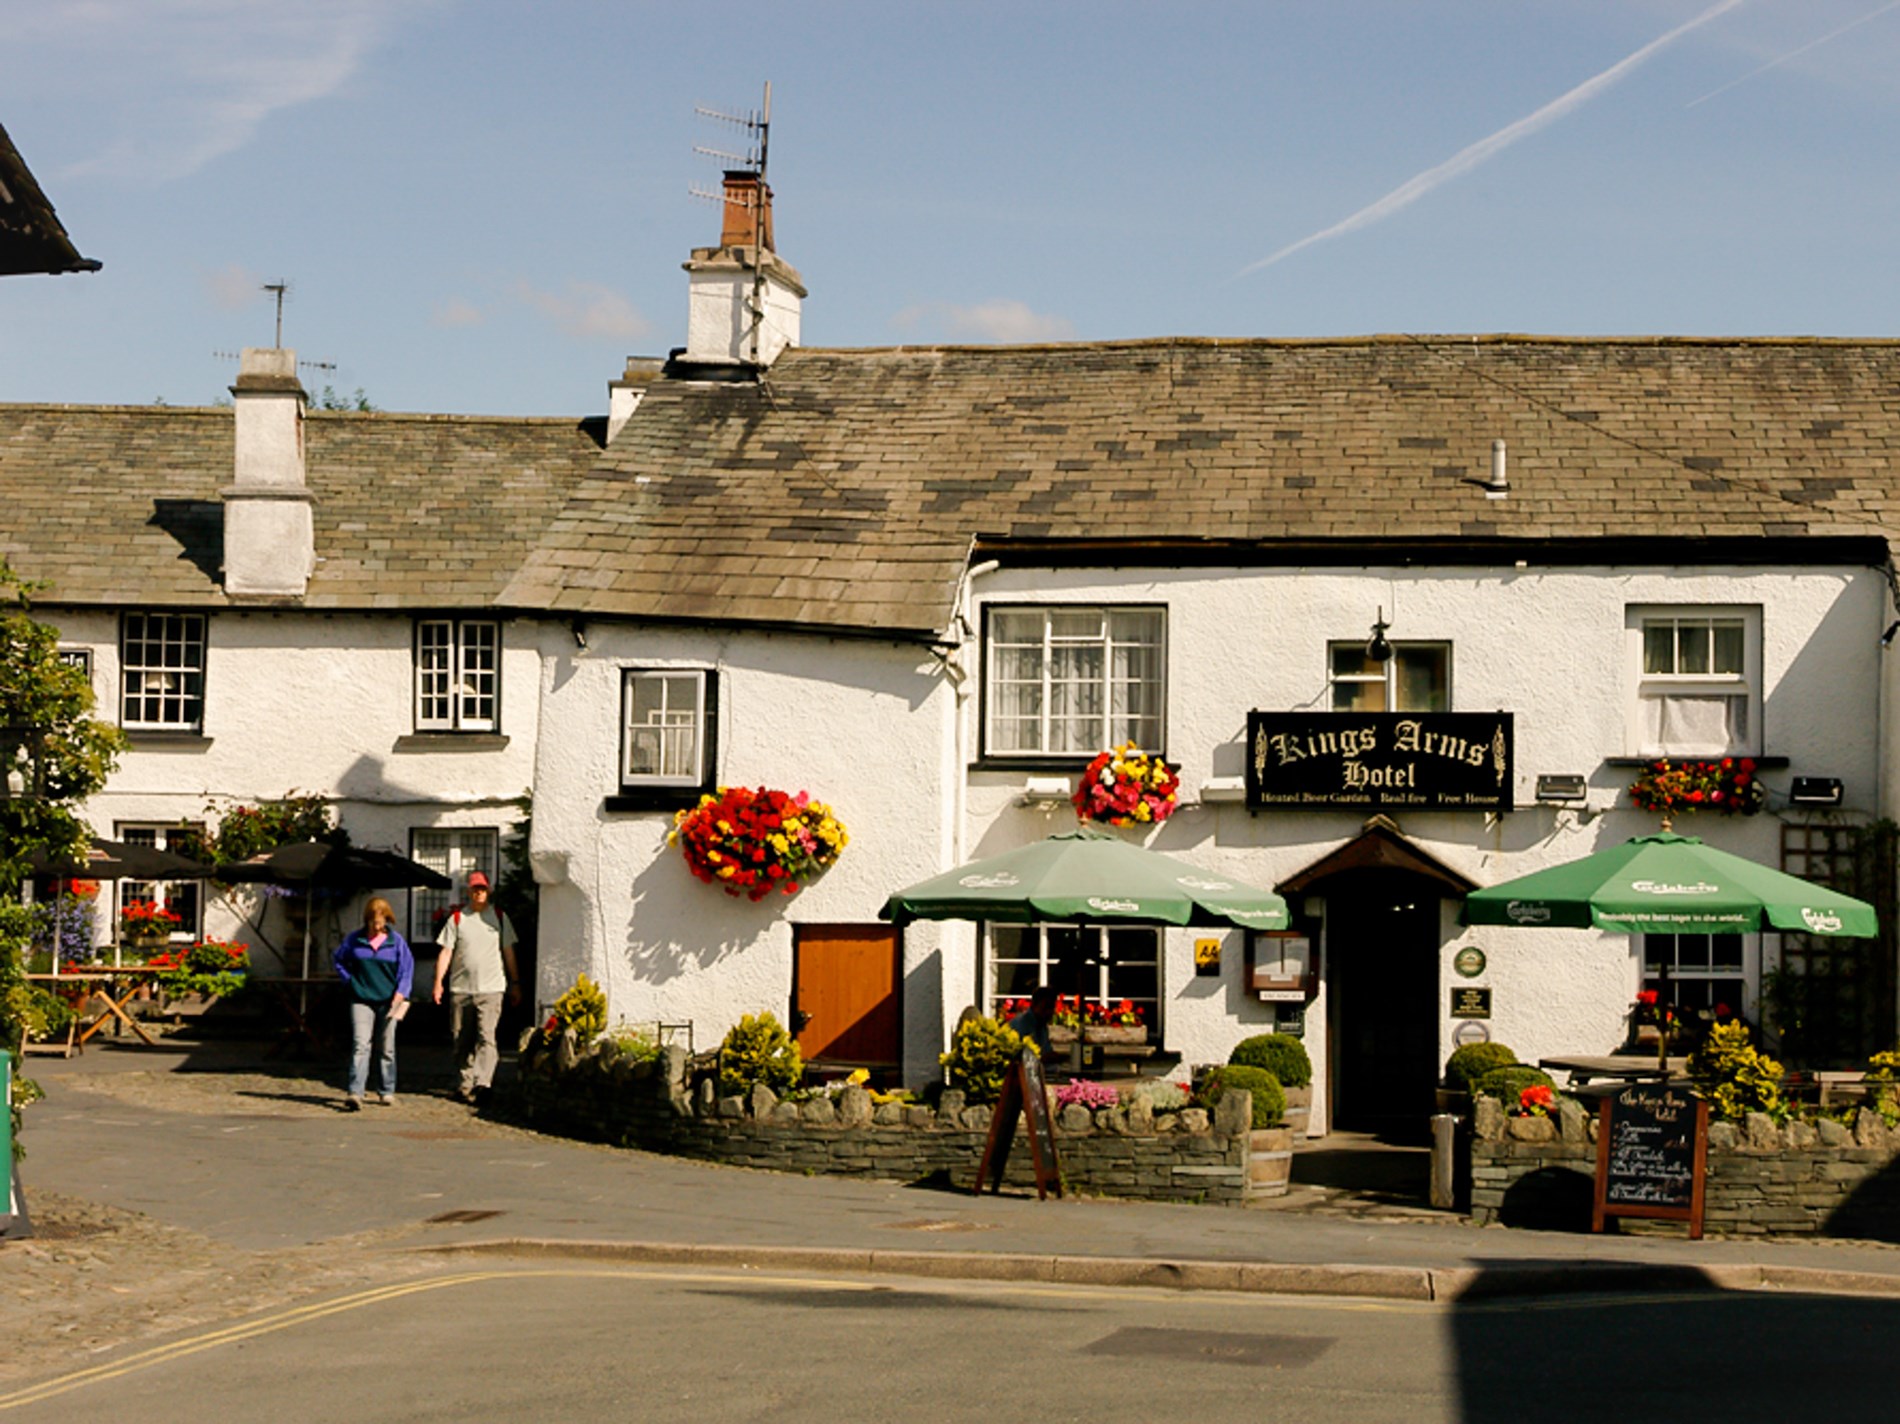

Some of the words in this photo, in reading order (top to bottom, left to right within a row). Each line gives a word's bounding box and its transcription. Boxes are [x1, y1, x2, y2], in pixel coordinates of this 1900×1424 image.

[1270, 725, 1377, 766] Kings
[1393, 720, 1490, 767] Arms
[1342, 761, 1416, 791] Hotel
[1302, 792, 1329, 803] Beer
[1329, 792, 1372, 803] Garden
[1438, 792, 1462, 804] Free
[1465, 792, 1500, 804] House
[1631, 880, 1719, 894] Carlsberg
[1506, 900, 1551, 923] Carlsberg
[1636, 913, 1651, 921] the
[1652, 913, 1670, 921] best
[1801, 907, 1842, 933] Carlsberg
[1200, 945, 1219, 957] AA
